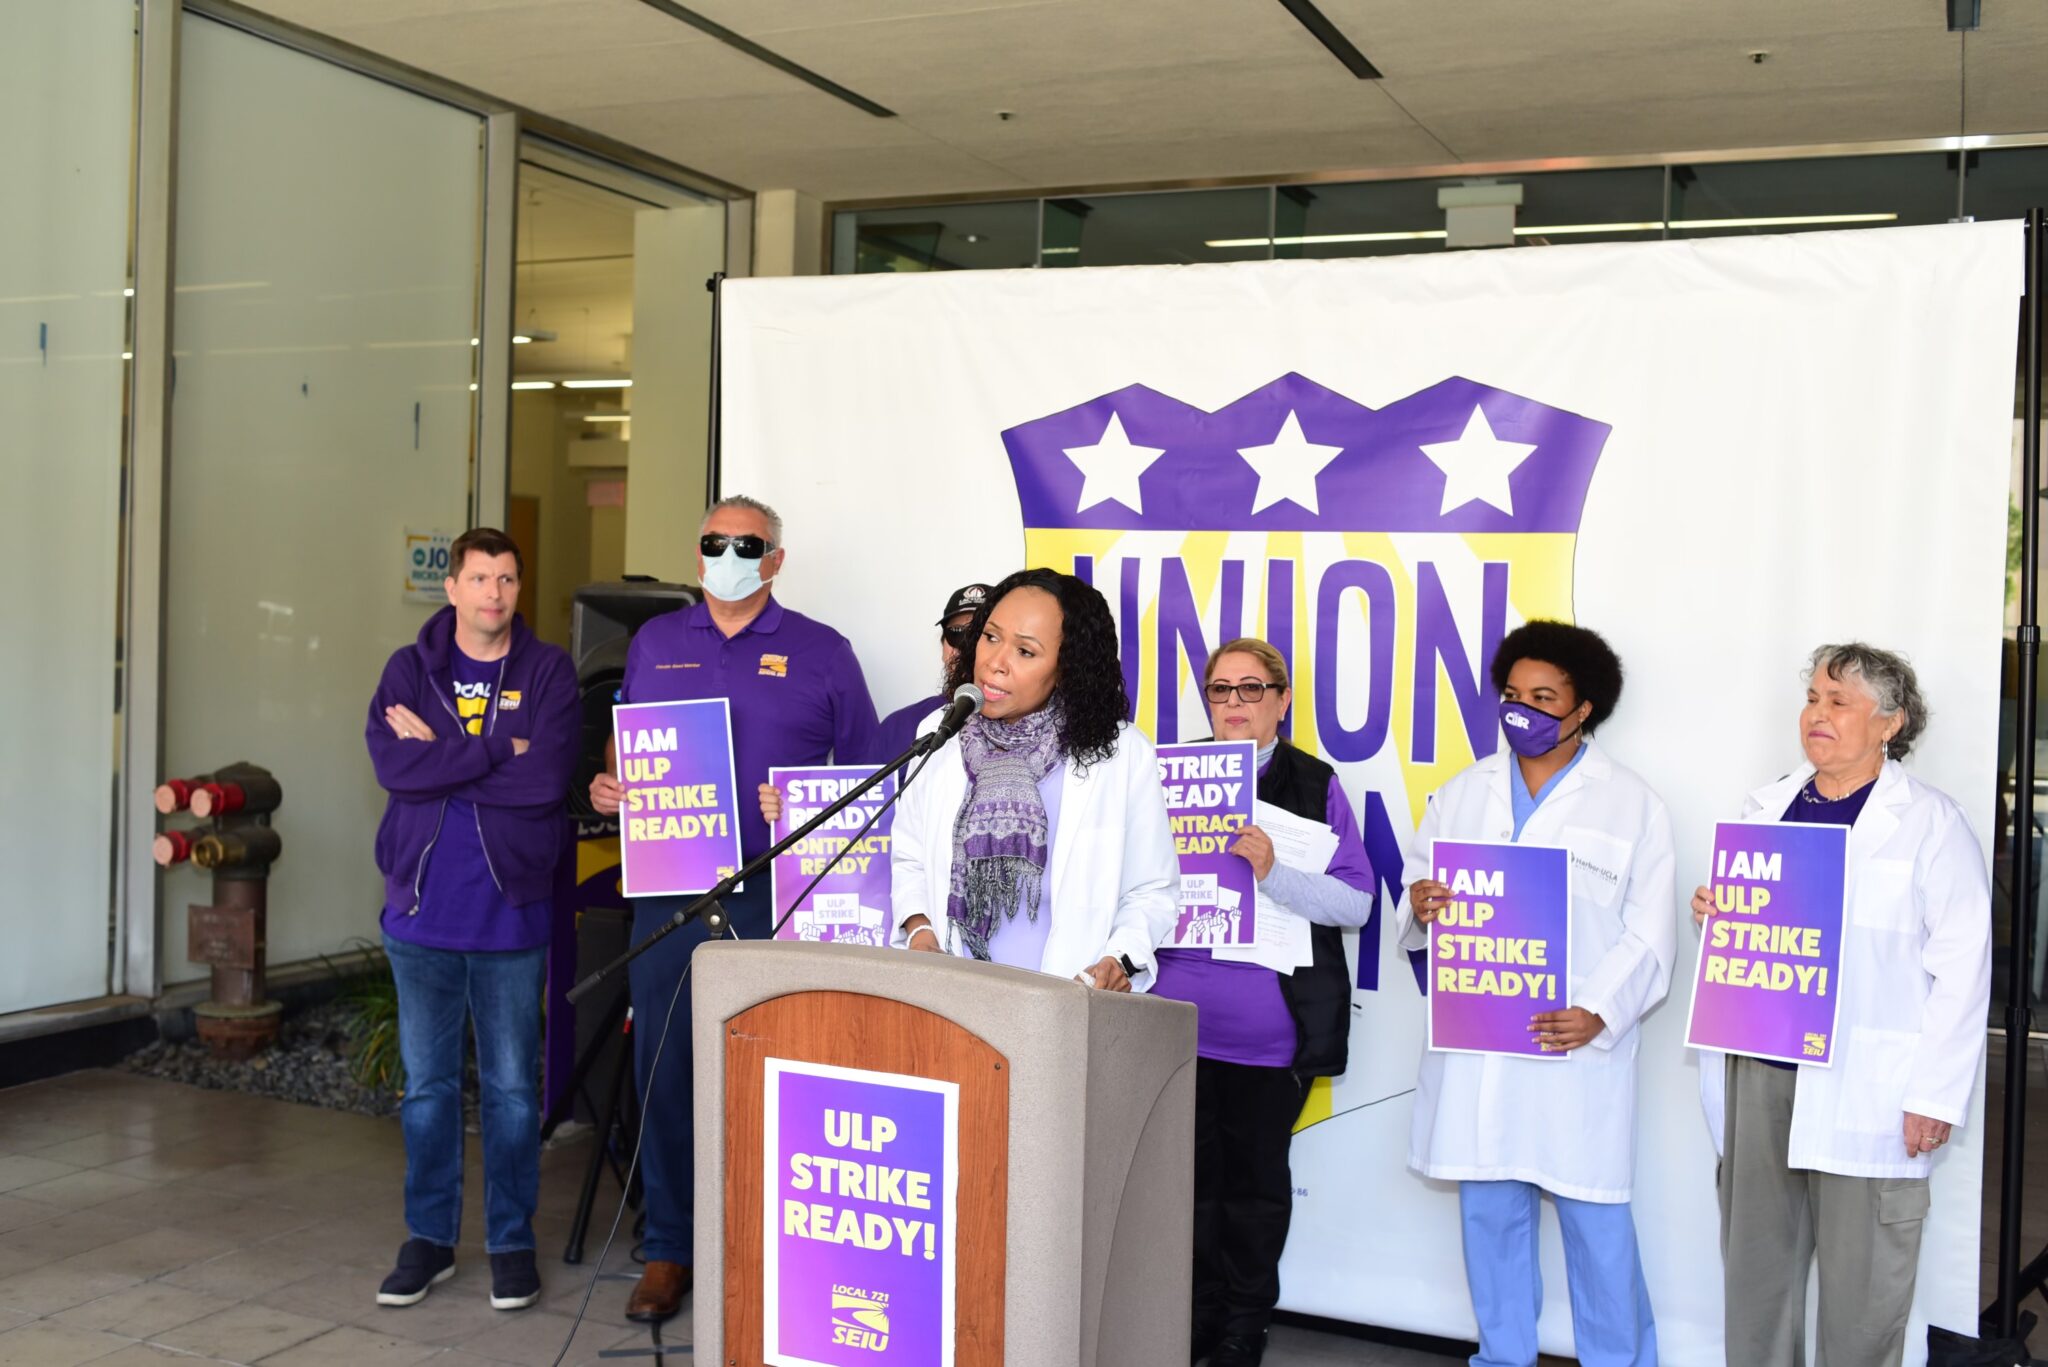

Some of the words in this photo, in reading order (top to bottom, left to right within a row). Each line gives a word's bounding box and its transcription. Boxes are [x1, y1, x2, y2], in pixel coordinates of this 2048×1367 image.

[453, 681, 491, 698] CAL
[622, 730, 631, 754] I
[634, 728, 678, 753] AM
[624, 757, 671, 782] ULP
[626, 784, 718, 812] STRIKE
[787, 778, 885, 803] STRIKE
[629, 813, 728, 842] READY!
[1170, 813, 1248, 834] NTRACT
[1174, 835, 1230, 855] EADY
[800, 856, 872, 876] READY
[1716, 849, 1727, 878] I
[1728, 851, 1782, 881] AM
[1186, 879, 1205, 889] ULP
[1451, 868, 1504, 897] AM
[827, 899, 845, 908] ULP
[1437, 899, 1494, 928] ULP
[1714, 884, 1771, 915] ULP
[818, 909, 854, 919] STRIKE
[1437, 933, 1547, 966] STRIKE
[1710, 920, 1822, 958] STRIKE
[1437, 966, 1556, 1000] READY!
[1704, 955, 1828, 997] READY!
[824, 1108, 897, 1153] ULP
[790, 1152, 931, 1210] STRIKE
[783, 1199, 936, 1261] READY!
[832, 1284, 868, 1298] LOCAL
[871, 1291, 889, 1302] 721
[832, 1326, 889, 1352] SEIU
